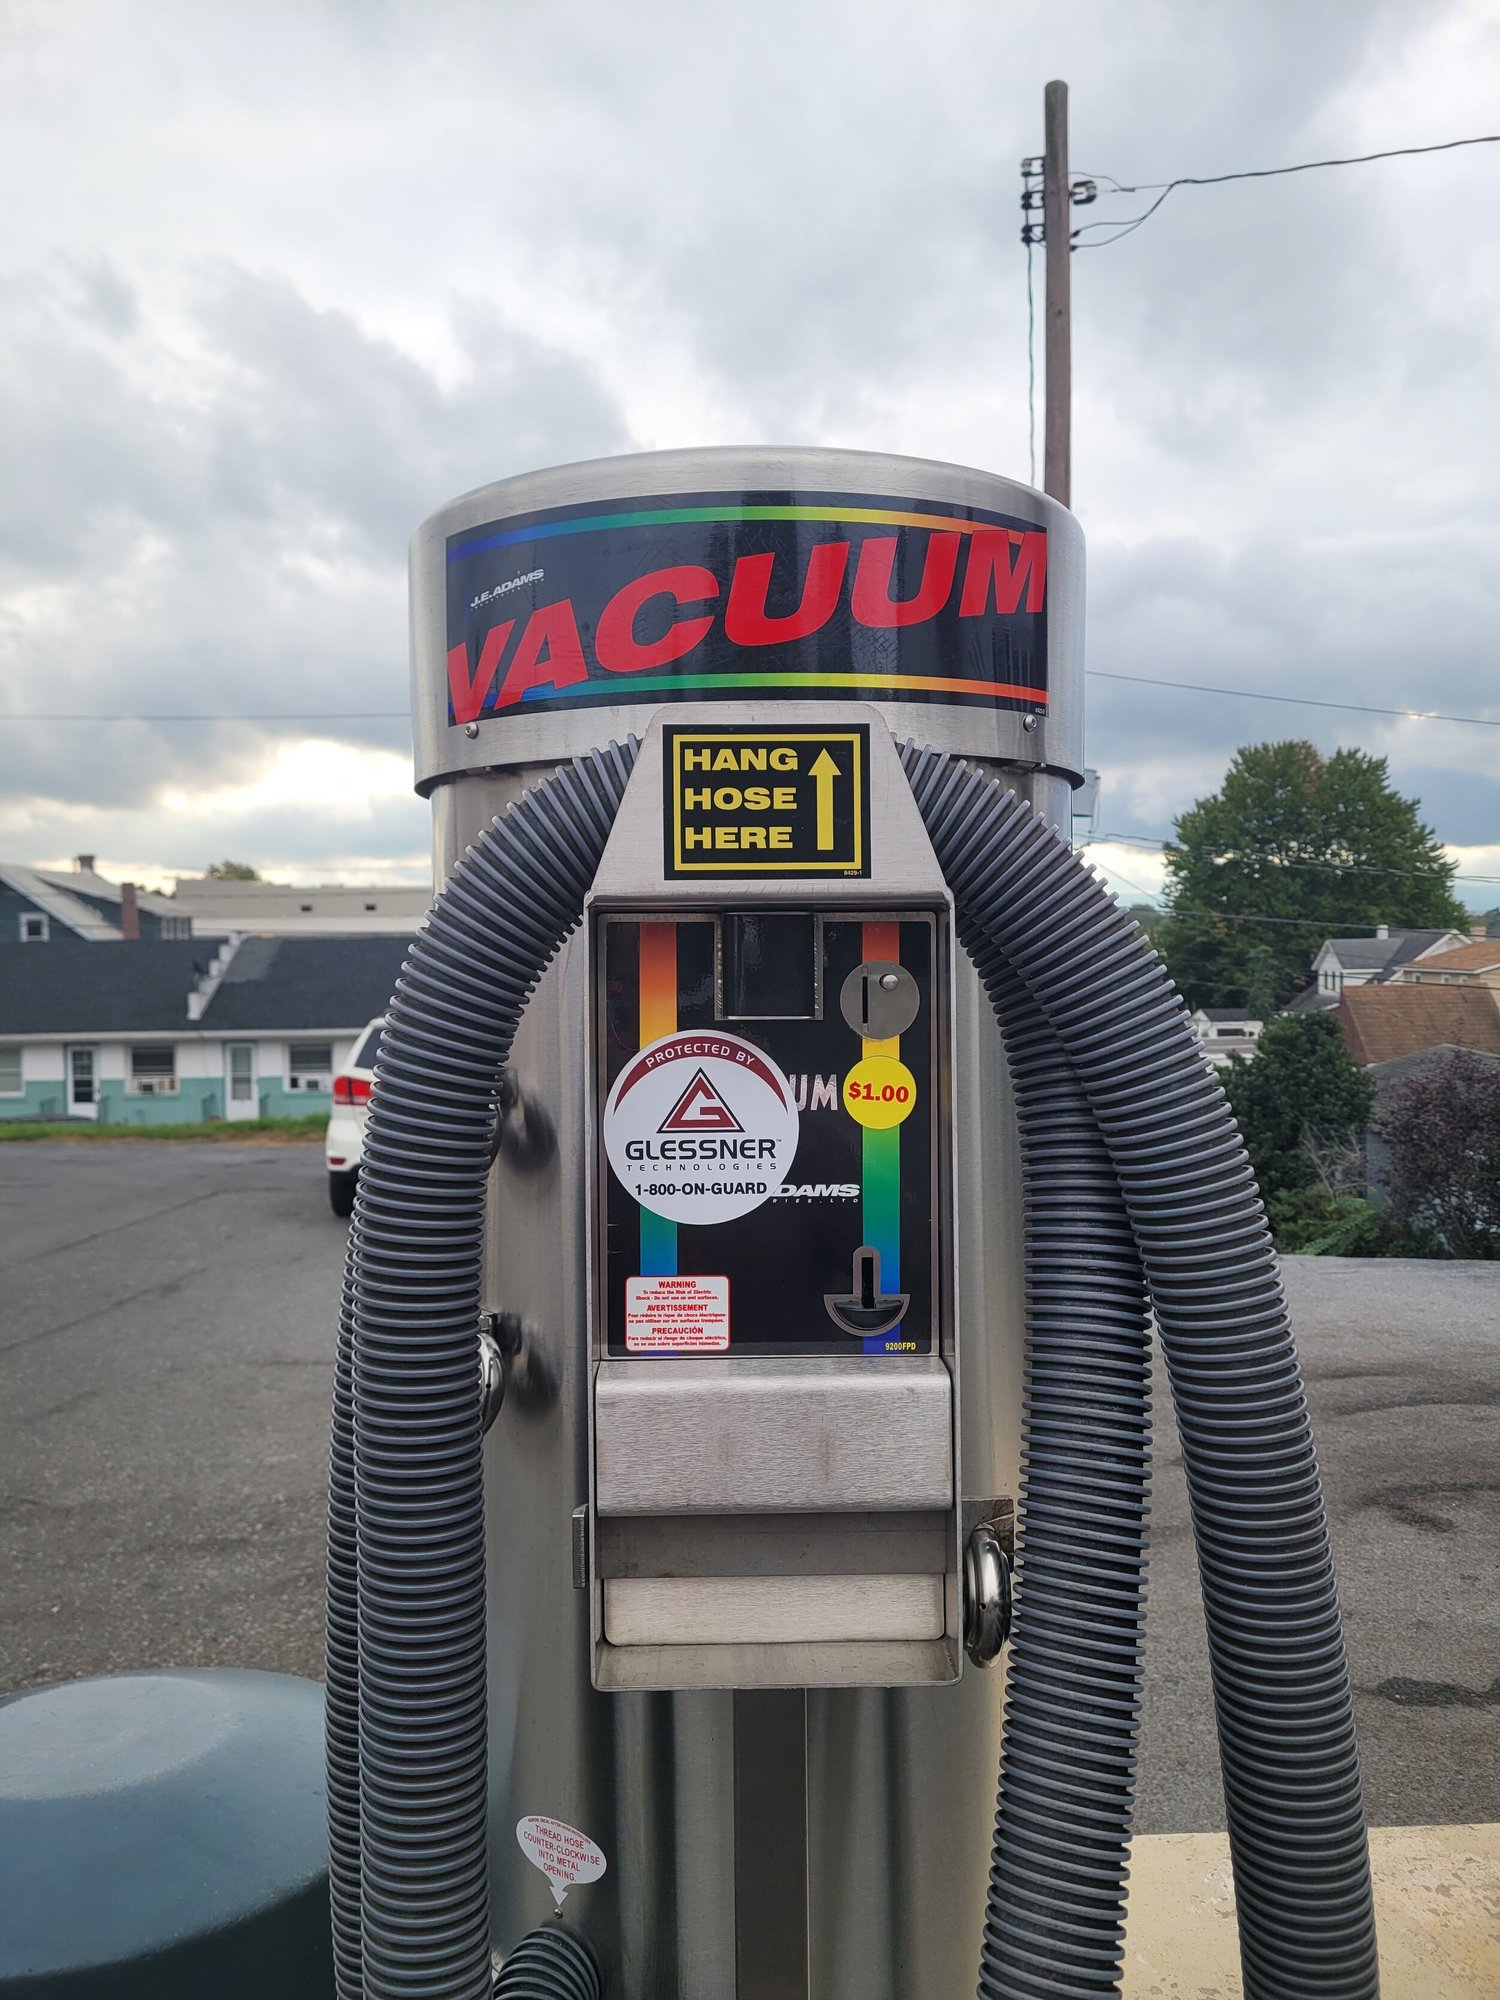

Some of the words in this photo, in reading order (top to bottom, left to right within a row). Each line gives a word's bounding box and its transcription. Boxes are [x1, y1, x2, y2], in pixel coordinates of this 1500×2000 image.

[447, 530, 1047, 725] VACUUM
[684, 747, 799, 771] HANG
[684, 787, 797, 810] HOSE
[685, 826, 793, 849] HERE
[645, 1043, 730, 1068] PROTECTED
[736, 1051, 755, 1066] BY
[848, 1081, 909, 1103] $1.00
[627, 1163, 776, 1172] TECHNOLOGIES
[635, 1182, 767, 1196] 1-800-ON-GUARD
[658, 1281, 697, 1289] WARNING
[647, 1304, 708, 1312] AVERTISSEMENT
[652, 1326, 704, 1334] PRECAUCIÓN
[885, 1342, 917, 1351] 9200FPD
[536, 1825, 561, 1841] THREAD
[564, 1836, 584, 1849] HOSE
[523, 1831, 600, 1866] COUNTER-CLOCKWISE
[539, 1849, 554, 1862] INTO
[557, 1856, 581, 1871] METAL
[543, 1862, 577, 1882] OPENING.
